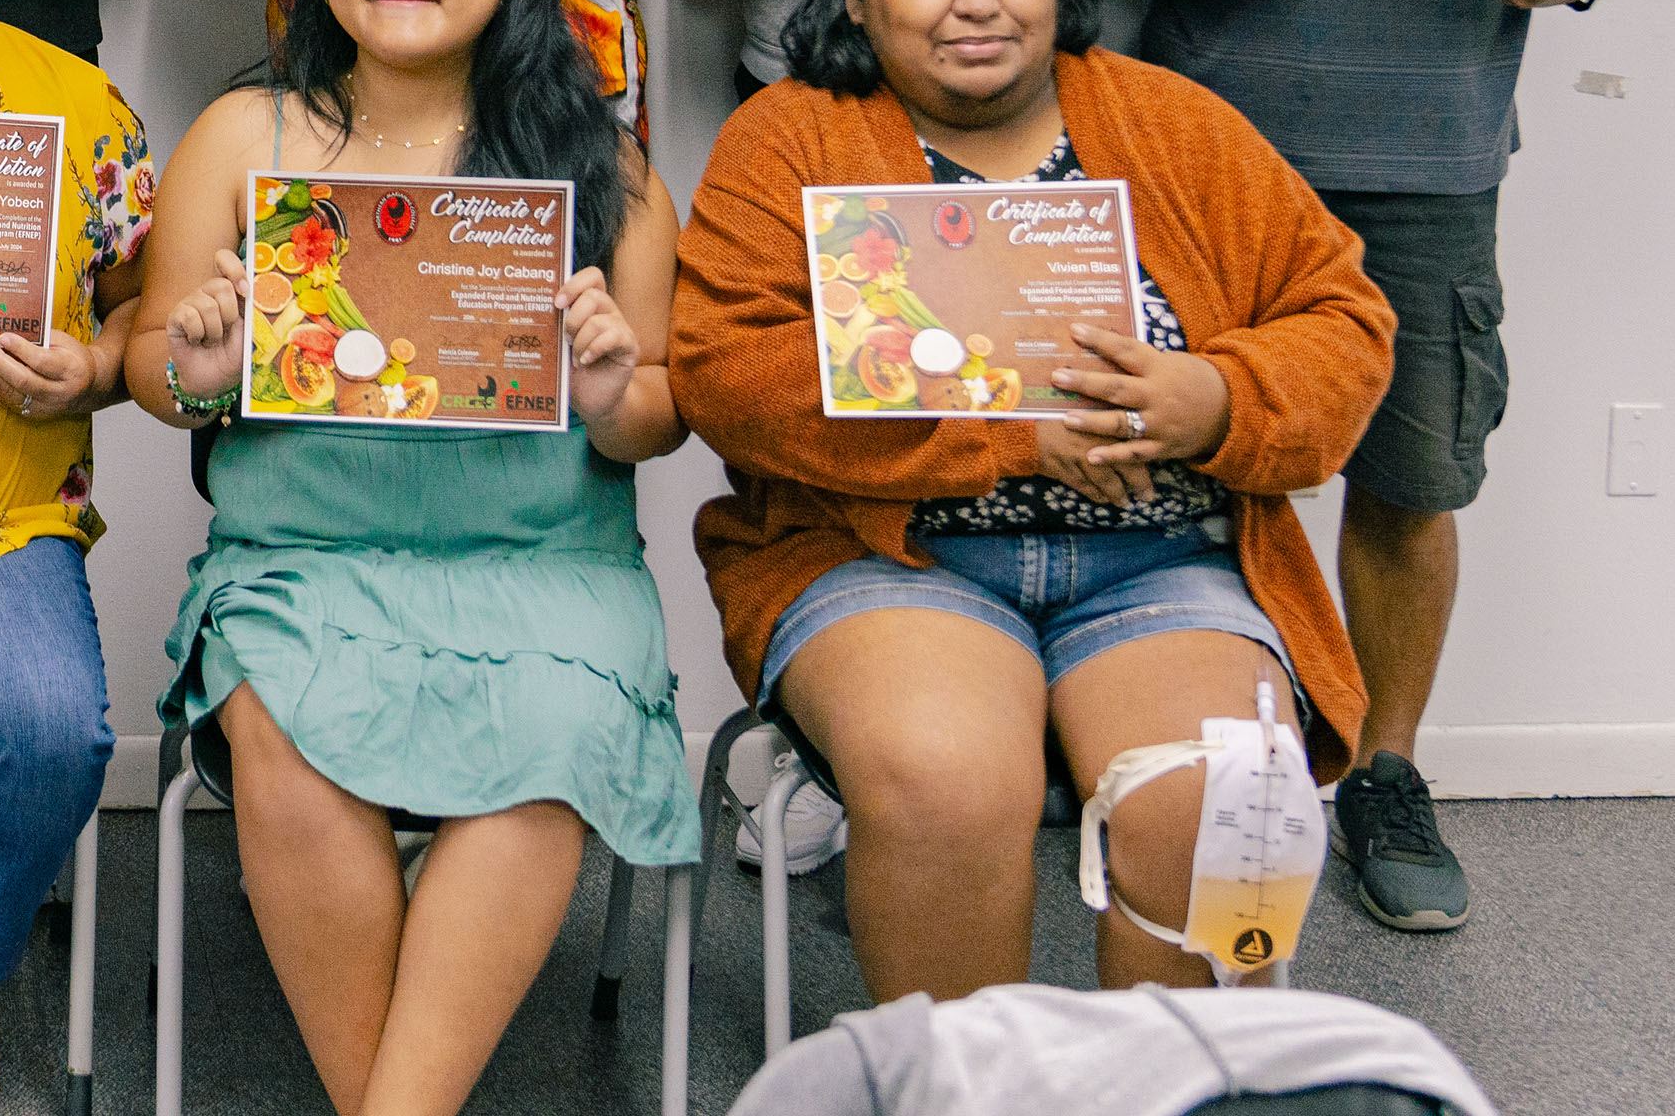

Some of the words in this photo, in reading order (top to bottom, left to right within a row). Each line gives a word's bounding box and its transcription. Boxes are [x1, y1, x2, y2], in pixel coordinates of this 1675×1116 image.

[26, 133, 47, 158] of
[12, 180, 36, 188] awarded
[431, 190, 530, 223] Certificate
[533, 198, 555, 226] of
[988, 196, 1085, 225] Certificate
[1089, 198, 1110, 224] of
[11, 221, 41, 230] Nutrition
[449, 217, 555, 248] Completion
[14, 230, 41, 240] (EFNEP)
[1009, 220, 1113, 247] Completion
[417, 262, 474, 275] Christine
[477, 264, 500, 279] Joy
[503, 265, 554, 282] Cabang
[1047, 261, 1087, 272] Vivien
[1089, 261, 1120, 272] Blas
[451, 291, 486, 300] Expanded
[486, 292, 504, 300] Food
[506, 293, 519, 301] and
[520, 293, 553, 302] Nutrition
[1019, 287, 1054, 295] Expanded
[457, 299, 492, 309] Education
[493, 301, 524, 312] Program
[524, 302, 553, 312] (EFNEP)
[505, 395, 555, 412] EFNEP
